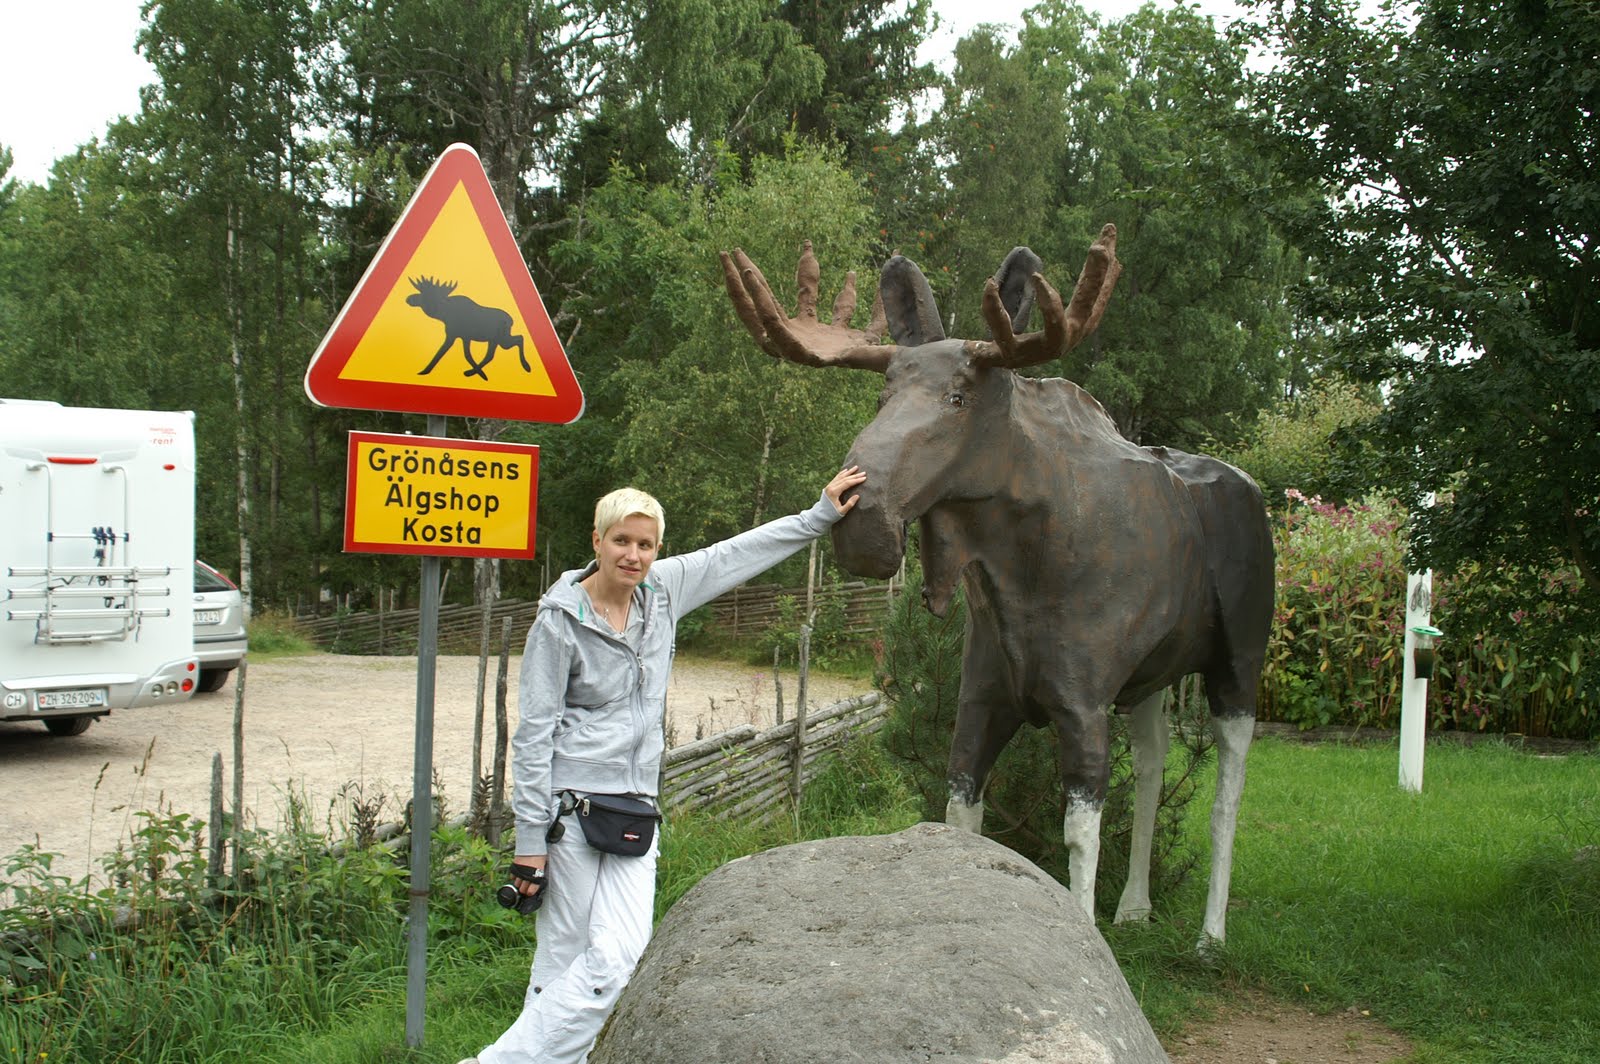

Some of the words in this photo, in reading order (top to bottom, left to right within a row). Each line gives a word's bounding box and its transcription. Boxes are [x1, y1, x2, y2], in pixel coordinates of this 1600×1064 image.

[368, 447, 519, 480] Grönåsens
[384, 475, 500, 518] Älgshop
[402, 517, 482, 545] Kosta
[7, 695, 22, 707] CH
